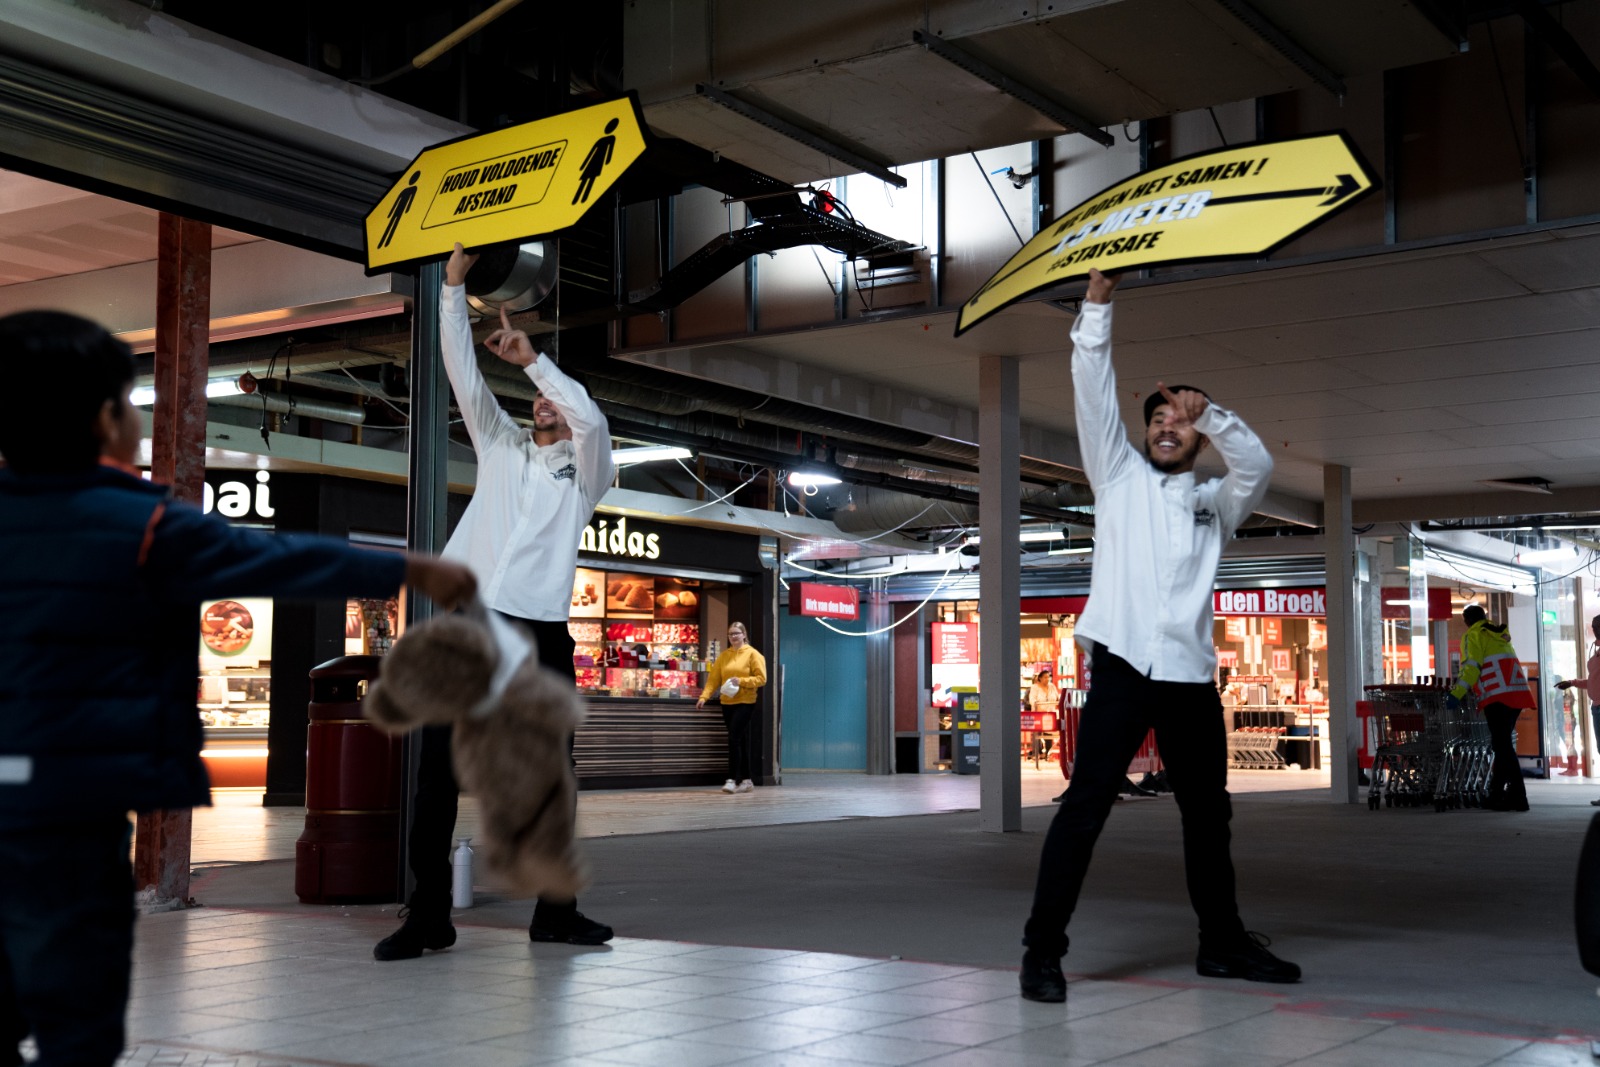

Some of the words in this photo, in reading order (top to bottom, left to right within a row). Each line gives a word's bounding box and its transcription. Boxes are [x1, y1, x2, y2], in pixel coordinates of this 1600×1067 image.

[440, 168, 480, 194] HOUD
[479, 147, 562, 185] VOLDOENDE
[1130, 174, 1174, 200] HET
[453, 184, 518, 215] AFSTAND
[1093, 190, 1213, 238] METER
[1045, 231, 1165, 275] #STAYSAFE
[578, 516, 660, 559] nidas
[1219, 590, 1260, 612] den
[1264, 589, 1326, 613] Broek
